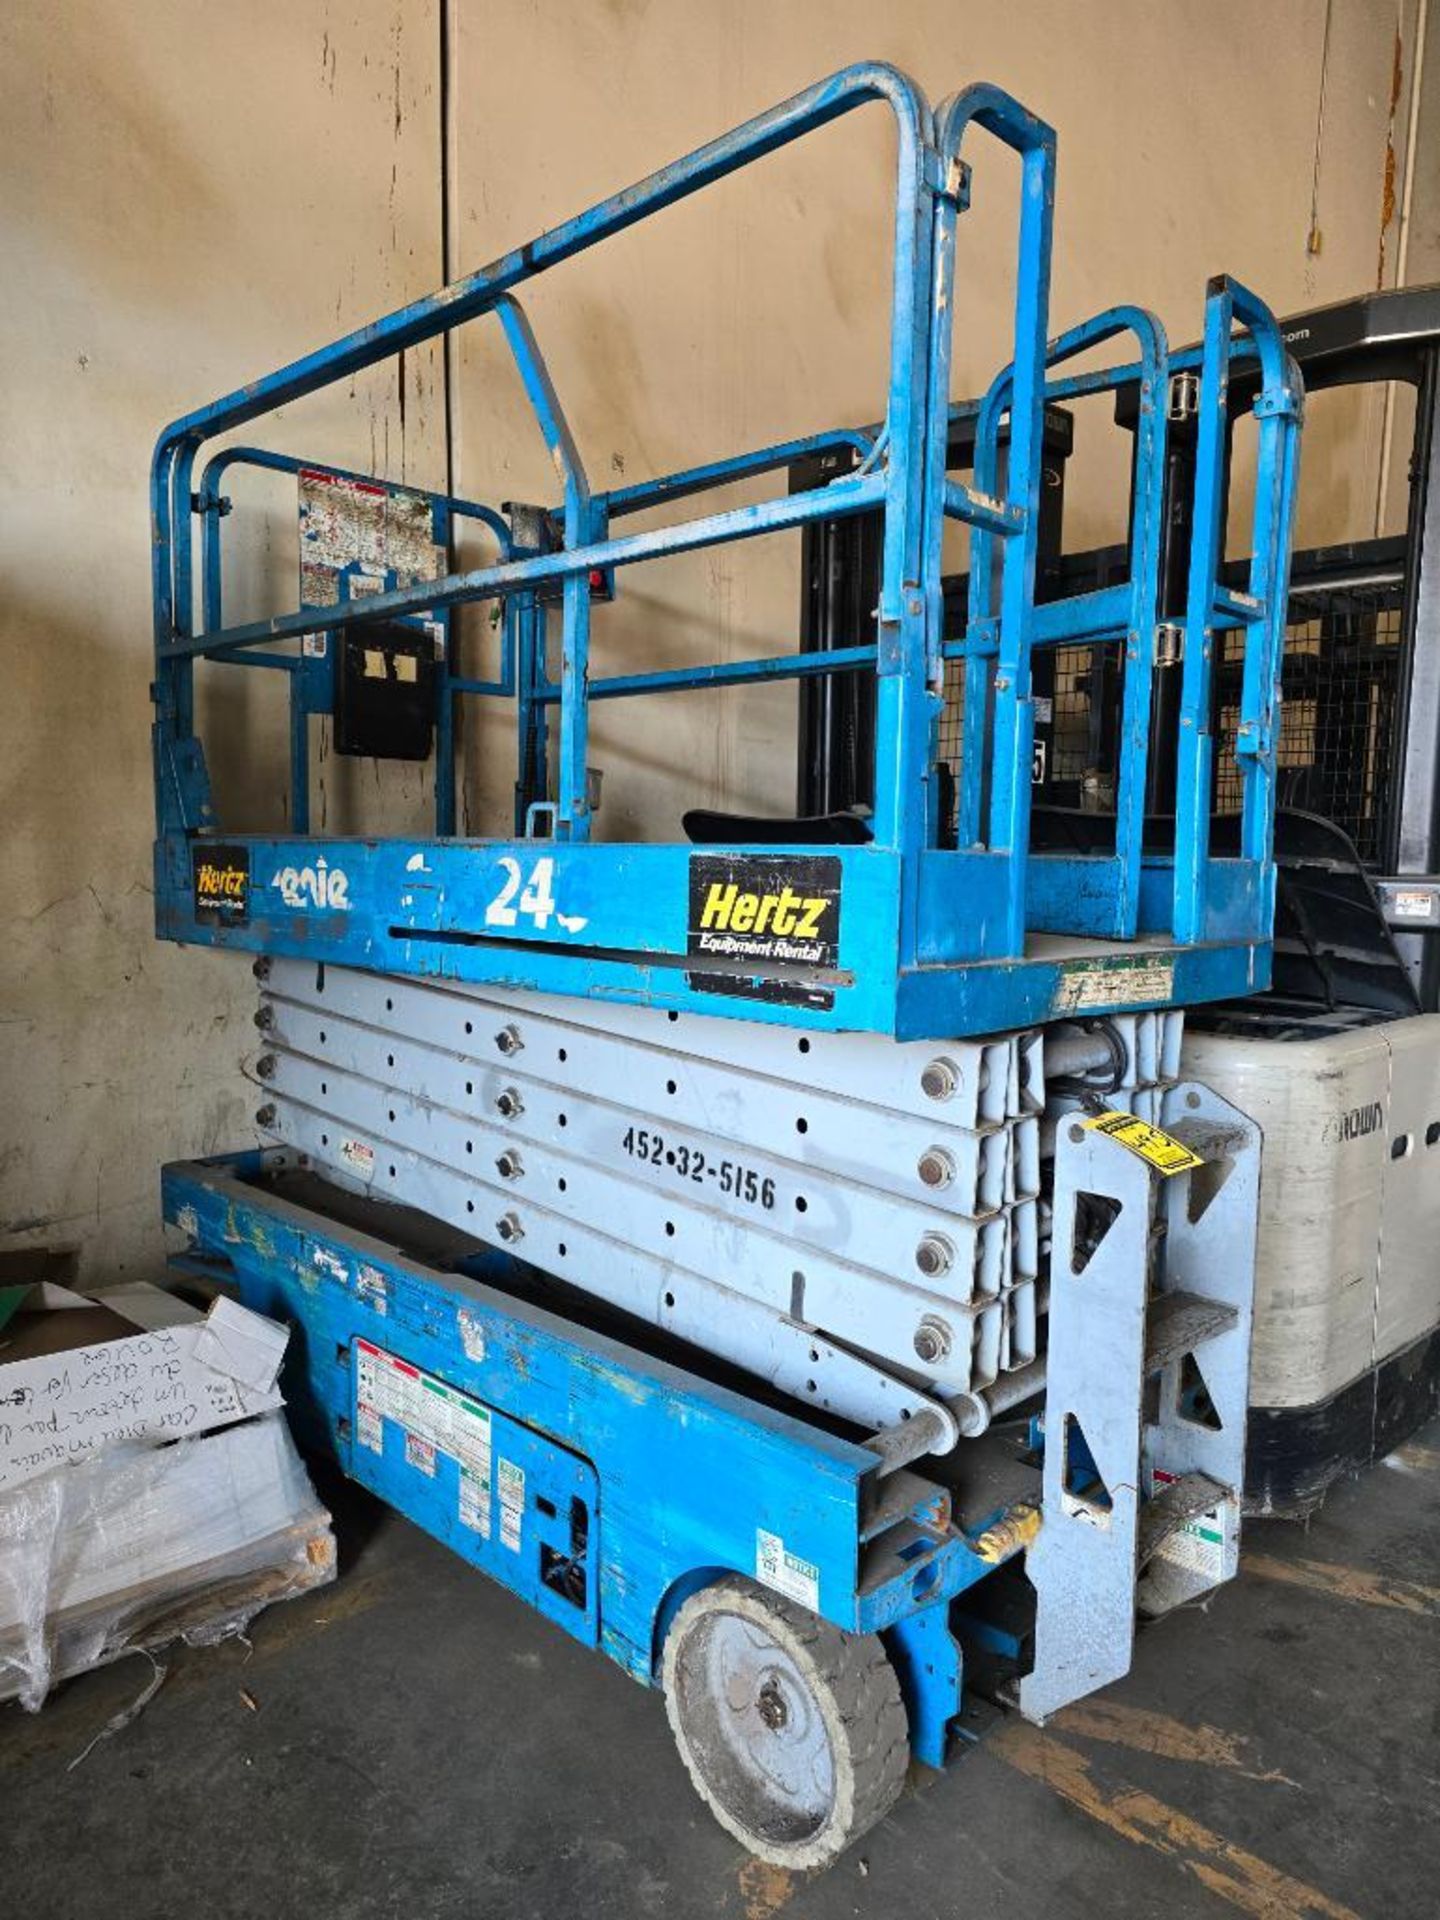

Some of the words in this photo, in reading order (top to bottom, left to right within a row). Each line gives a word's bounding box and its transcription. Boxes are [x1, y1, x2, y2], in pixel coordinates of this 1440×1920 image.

[198, 866, 247, 896] Hertz
[272, 855, 350, 910] enie
[485, 857, 588, 934] 24
[700, 884, 830, 938] Hertz
[700, 933, 773, 956] Equipment
[773, 940, 822, 962] Rental
